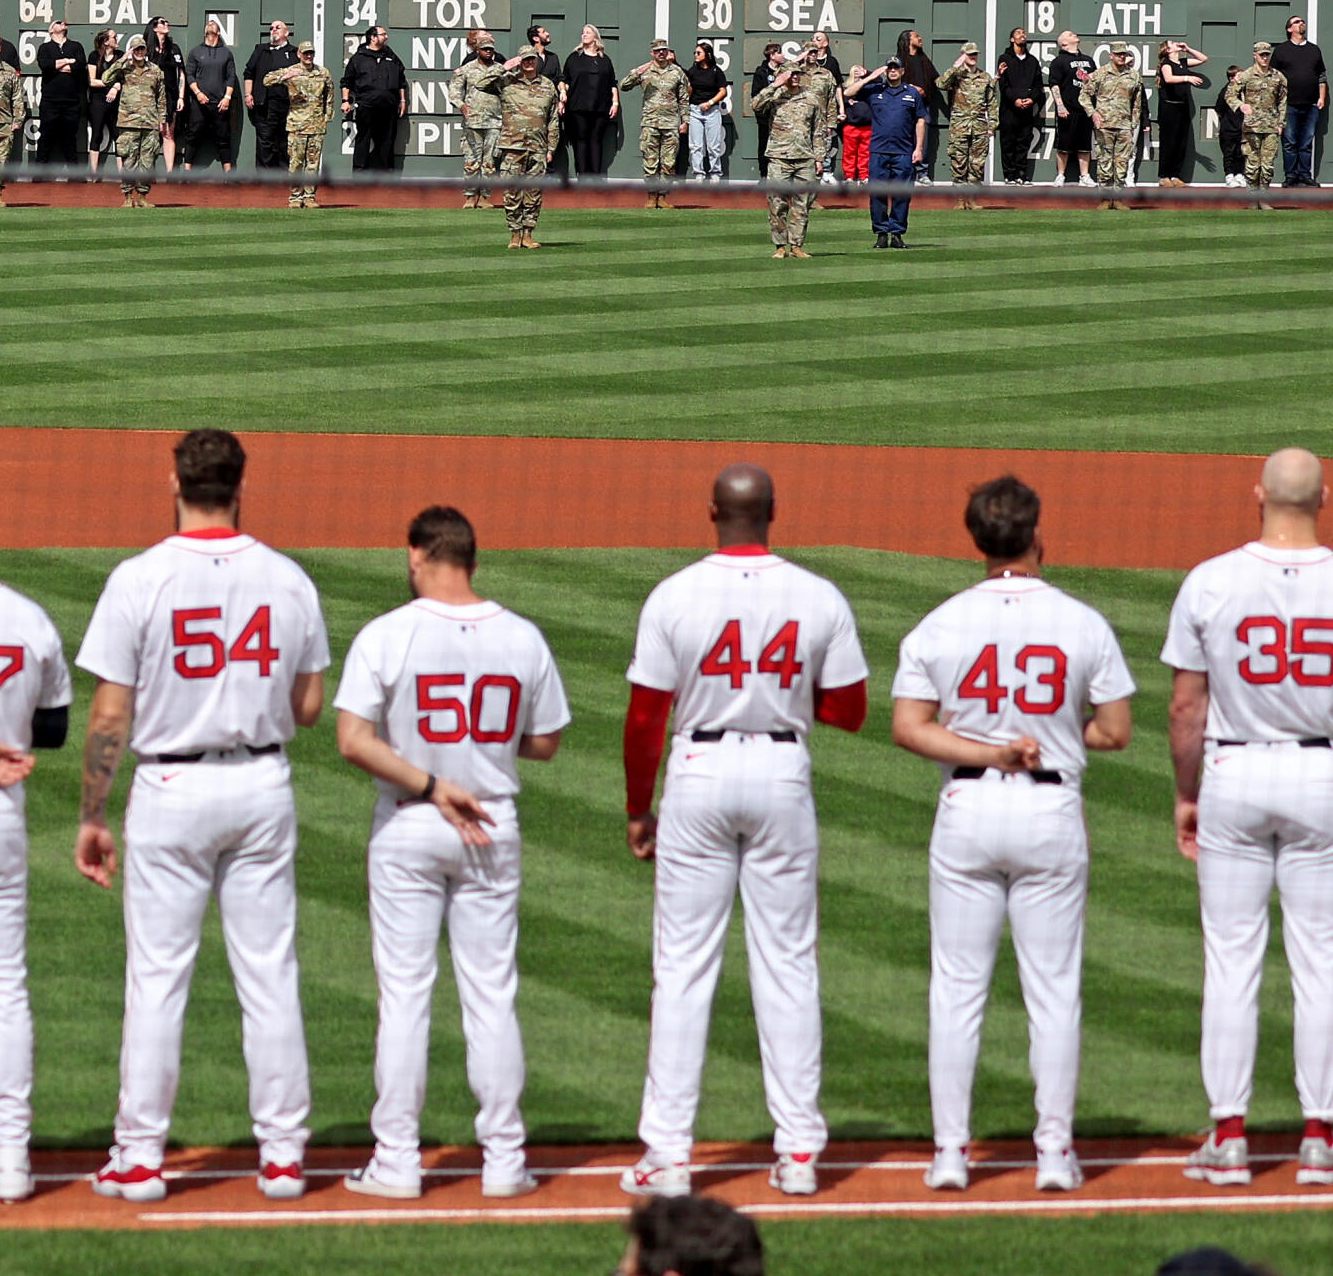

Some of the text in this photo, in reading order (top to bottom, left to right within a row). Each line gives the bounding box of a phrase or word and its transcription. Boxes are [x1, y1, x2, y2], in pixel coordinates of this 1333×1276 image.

[769, 0, 839, 31] SEA
[1028, 1, 1161, 35] 18 ATH
[412, 37, 467, 69] NY
[172, 605, 279, 679] 54
[700, 620, 802, 689] 44
[1236, 616, 1333, 687] 35
[417, 674, 521, 743] 50
[958, 644, 1068, 715] 43
